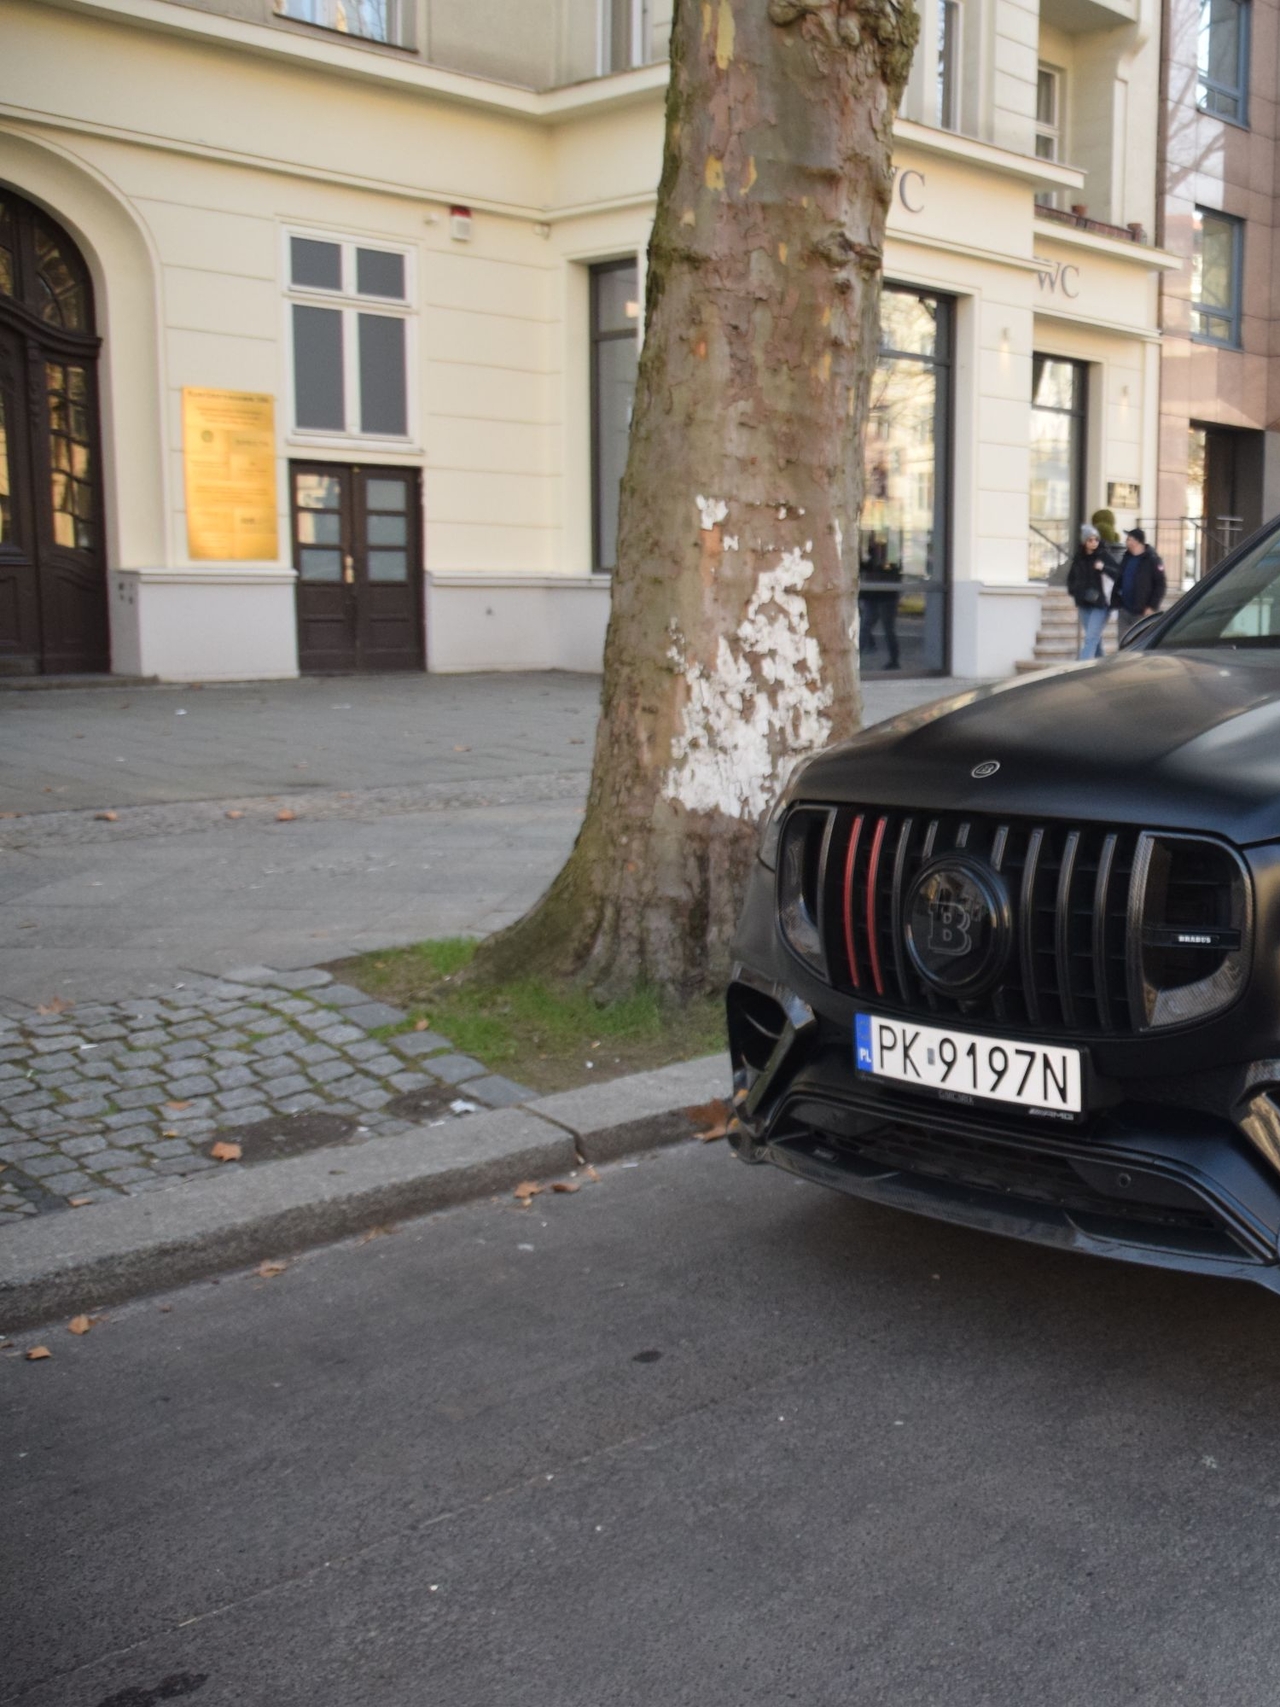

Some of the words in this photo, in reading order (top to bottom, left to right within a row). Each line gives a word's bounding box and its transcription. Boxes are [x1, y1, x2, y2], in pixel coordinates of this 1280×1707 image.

[928, 901, 972, 956] B
[860, 1047, 872, 1063] PL
[879, 1024, 921, 1078] PK
[939, 1037, 1067, 1104] 9197N
